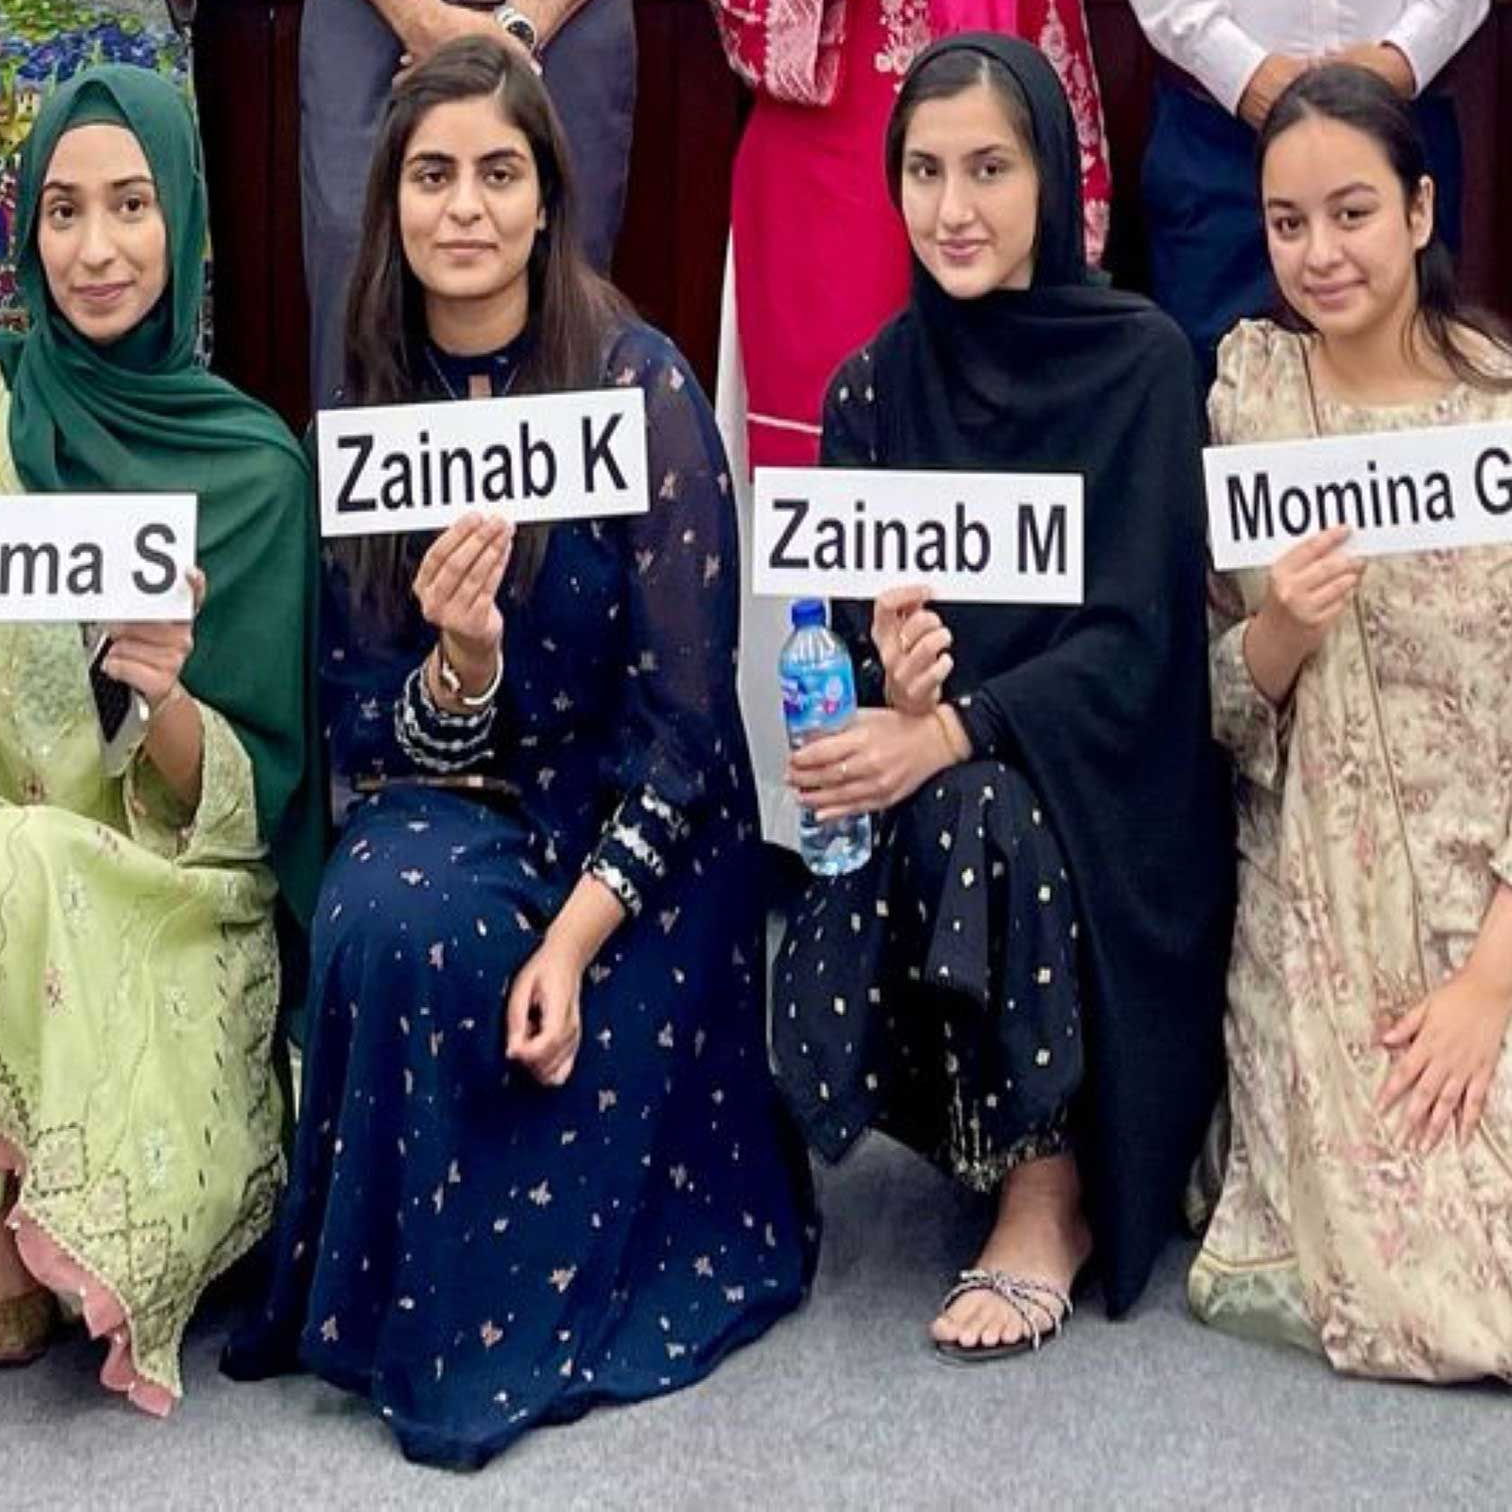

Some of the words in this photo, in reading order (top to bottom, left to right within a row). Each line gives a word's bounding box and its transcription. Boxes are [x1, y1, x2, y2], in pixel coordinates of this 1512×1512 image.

[336, 421, 557, 513] Zainab
[581, 413, 628, 493] K
[1226, 461, 1455, 542] Momina
[132, 523, 177, 595] S
[768, 499, 991, 573] Zainab
[1017, 504, 1067, 575] M
